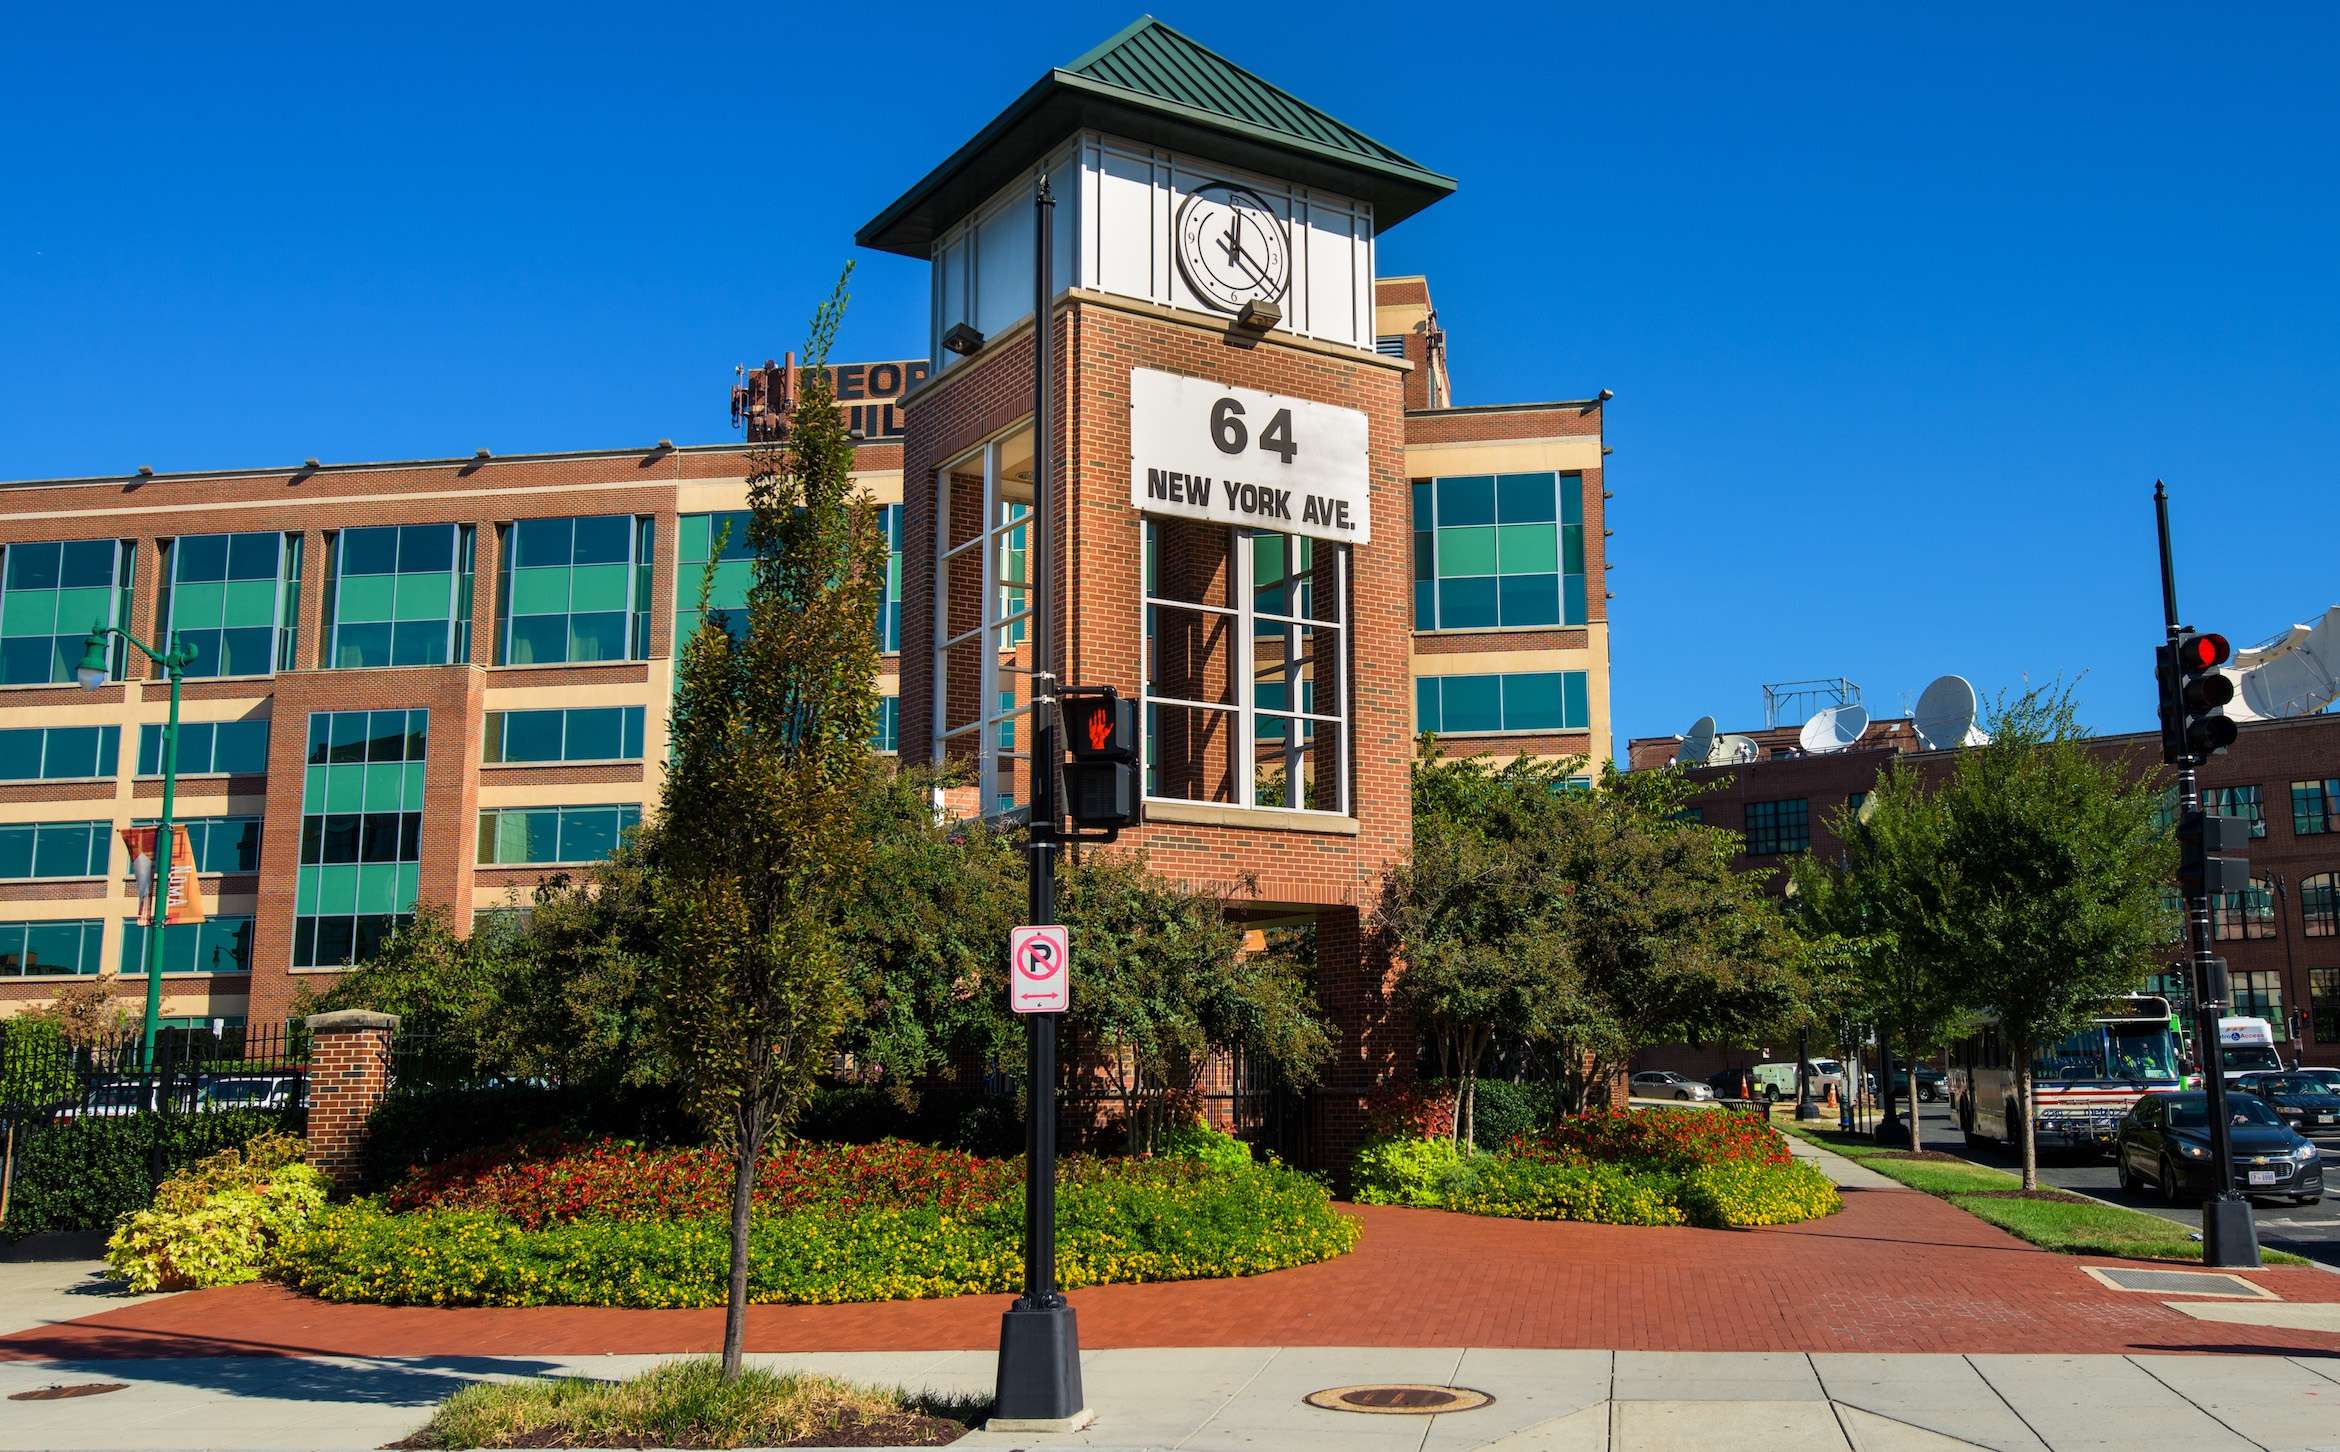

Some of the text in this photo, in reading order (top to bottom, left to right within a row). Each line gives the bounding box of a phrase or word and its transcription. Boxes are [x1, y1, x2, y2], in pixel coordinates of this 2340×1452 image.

[1230, 290, 1238, 302] 6
[1210, 397, 1298, 464] 64
[1148, 468, 1355, 530] NEW YORK AVE.
